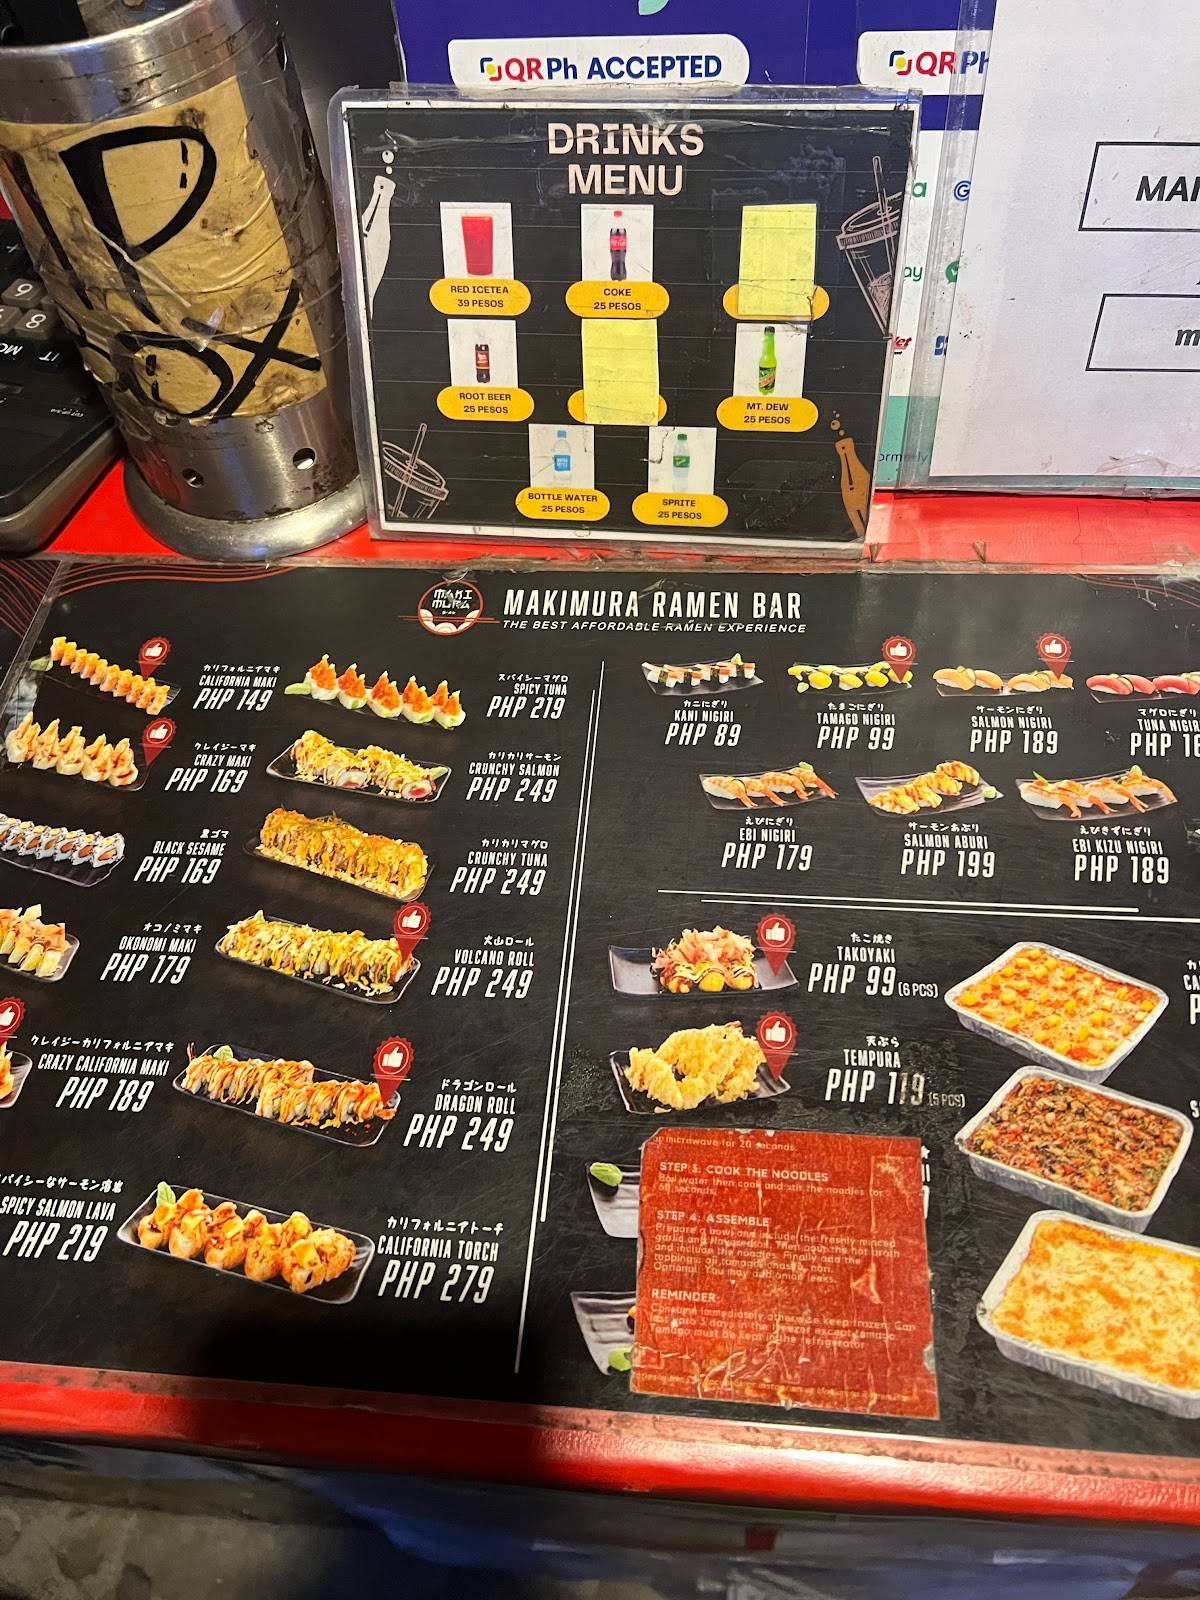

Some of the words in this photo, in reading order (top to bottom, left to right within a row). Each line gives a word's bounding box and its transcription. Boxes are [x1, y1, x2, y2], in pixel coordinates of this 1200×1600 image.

[587, 56, 721, 80] ACCEPTED
[548, 122, 704, 156] DRINKS
[568, 164, 683, 195] MENU
[473, 286, 509, 294] ICETEA
[609, 302, 641, 310] PESOS
[488, 393, 511, 401] BEER
[766, 403, 788, 411] DEW
[478, 406, 508, 414] PESOS
[759, 416, 791, 424] PESOS
[528, 493, 562, 501] BOTTLE
[565, 494, 597, 502] WATER
[662, 499, 696, 507] SPRITE
[503, 589, 640, 617] MAKIMURA
[652, 591, 738, 619] RAMEN
[752, 592, 801, 619] BAR
[502, 620, 528, 629] THE
[532, 620, 567, 630] BEST
[571, 621, 660, 631] AFFORDABLE
[665, 622, 712, 632] RAMEN
[718, 623, 807, 633] EXPERIENCE
[199, 675, 250, 689] CALIFORNIA
[253, 677, 277, 687] MAKI
[514, 683, 540, 694] SPICY
[545, 684, 566, 695] TUNA
[193, 688, 233, 709] PHP
[237, 689, 273, 710] 149
[487, 696, 527, 717] PHP
[530, 697, 565, 719] 219
[675, 710, 698, 721] KANI
[702, 711, 733, 722] NIGIRI
[817, 713, 858, 725] TAMAGO
[863, 714, 895, 725] NIGIRI
[972, 716, 1014, 730] SALMON
[1018, 717, 1052, 731] NIGIRI
[1137, 719, 1166, 731] TUNA
[1169, 720, 1200, 732] NIGIR
[665, 723, 707, 745] PHP
[714, 724, 741, 746] 89
[817, 726, 859, 749] PHP
[868, 727, 894, 750] 99
[970, 729, 1011, 752] PHP
[1023, 730, 1057, 754] 189
[1131, 733, 1171, 756] PHP
[194, 754, 227, 766] CRAZY
[226, 755, 251, 767] MAKI
[469, 762, 515, 775] CRUNCHY
[519, 764, 559, 776] SALMON
[165, 768, 206, 791] PHP
[210, 769, 248, 792] 169
[466, 777, 510, 801] PHP
[515, 778, 557, 802] 249
[740, 828, 756, 841] EBI
[762, 829, 795, 842] NIGIRI
[904, 834, 949, 850] SALMON
[955, 835, 988, 849] ABURI
[151, 841, 185, 857] BLACK
[186, 842, 226, 856] SESAME
[722, 843, 766, 868] PHP
[777, 844, 812, 870] 179
[1073, 839, 1091, 852] EBI
[1095, 840, 1122, 853] KIZU
[1126, 841, 1162, 857] NIGIRI
[468, 851, 516, 865] CRUNCHY
[521, 853, 547, 866] TUNA
[901, 849, 945, 875] PHP
[958, 851, 995, 877] 199
[134, 856, 182, 882] PHP
[181, 858, 221, 884] 169
[1075, 855, 1118, 882] PHP
[1131, 856, 1168, 883] 189
[450, 867, 496, 893] PHP
[501, 869, 546, 895] 249
[119, 936, 169, 951] OKONOMI
[168, 938, 196, 953] MAKI
[455, 949, 504, 965] VOLCANO
[508, 951, 534, 966] ROLL
[835, 946, 895, 965] TAKOYAKI
[100, 953, 151, 982] PHP
[150, 955, 191, 984] 179
[431, 967, 481, 996] PHP
[485, 969, 533, 998] 249
[808, 963, 855, 993] PHP
[866, 966, 896, 995] 99
[912, 983, 938, 998] PCS)
[38, 1054, 77, 1071] CRAZY
[75, 1056, 137, 1074] CALIFORNIA
[140, 1059, 169, 1076] MAKI
[844, 1049, 900, 1068] TEMPURA
[56, 1077, 111, 1110] PHP
[107, 1079, 154, 1112] 189
[825, 1069, 875, 1102] PHP
[435, 1094, 482, 1112] DRAGON
[487, 1097, 515, 1114] ROLL
[403, 1114, 457, 1148] PHP
[462, 1117, 513, 1151] 249
[660, 1162, 688, 1173] STEP
[706, 1165, 740, 1176] COOK
[746, 1167, 768, 1178] THE
[772, 1169, 829, 1182] NOODLES
[0, 1196, 37, 1215] SPICY
[35, 1198, 87, 1219] SALMON
[84, 1202, 116, 1221] LAVA
[657, 1210, 685, 1221] STEP
[706, 1213, 769, 1227] ASSEMBLE
[3, 1221, 62, 1259] PHP
[56, 1223, 108, 1261] 219
[378, 1235, 451, 1258] CALIFORNIA
[458, 1240, 498, 1261] TORCH
[378, 1260, 436, 1298] PHP
[440, 1264, 494, 1303] 279
[652, 1288, 716, 1303] REMINDER
